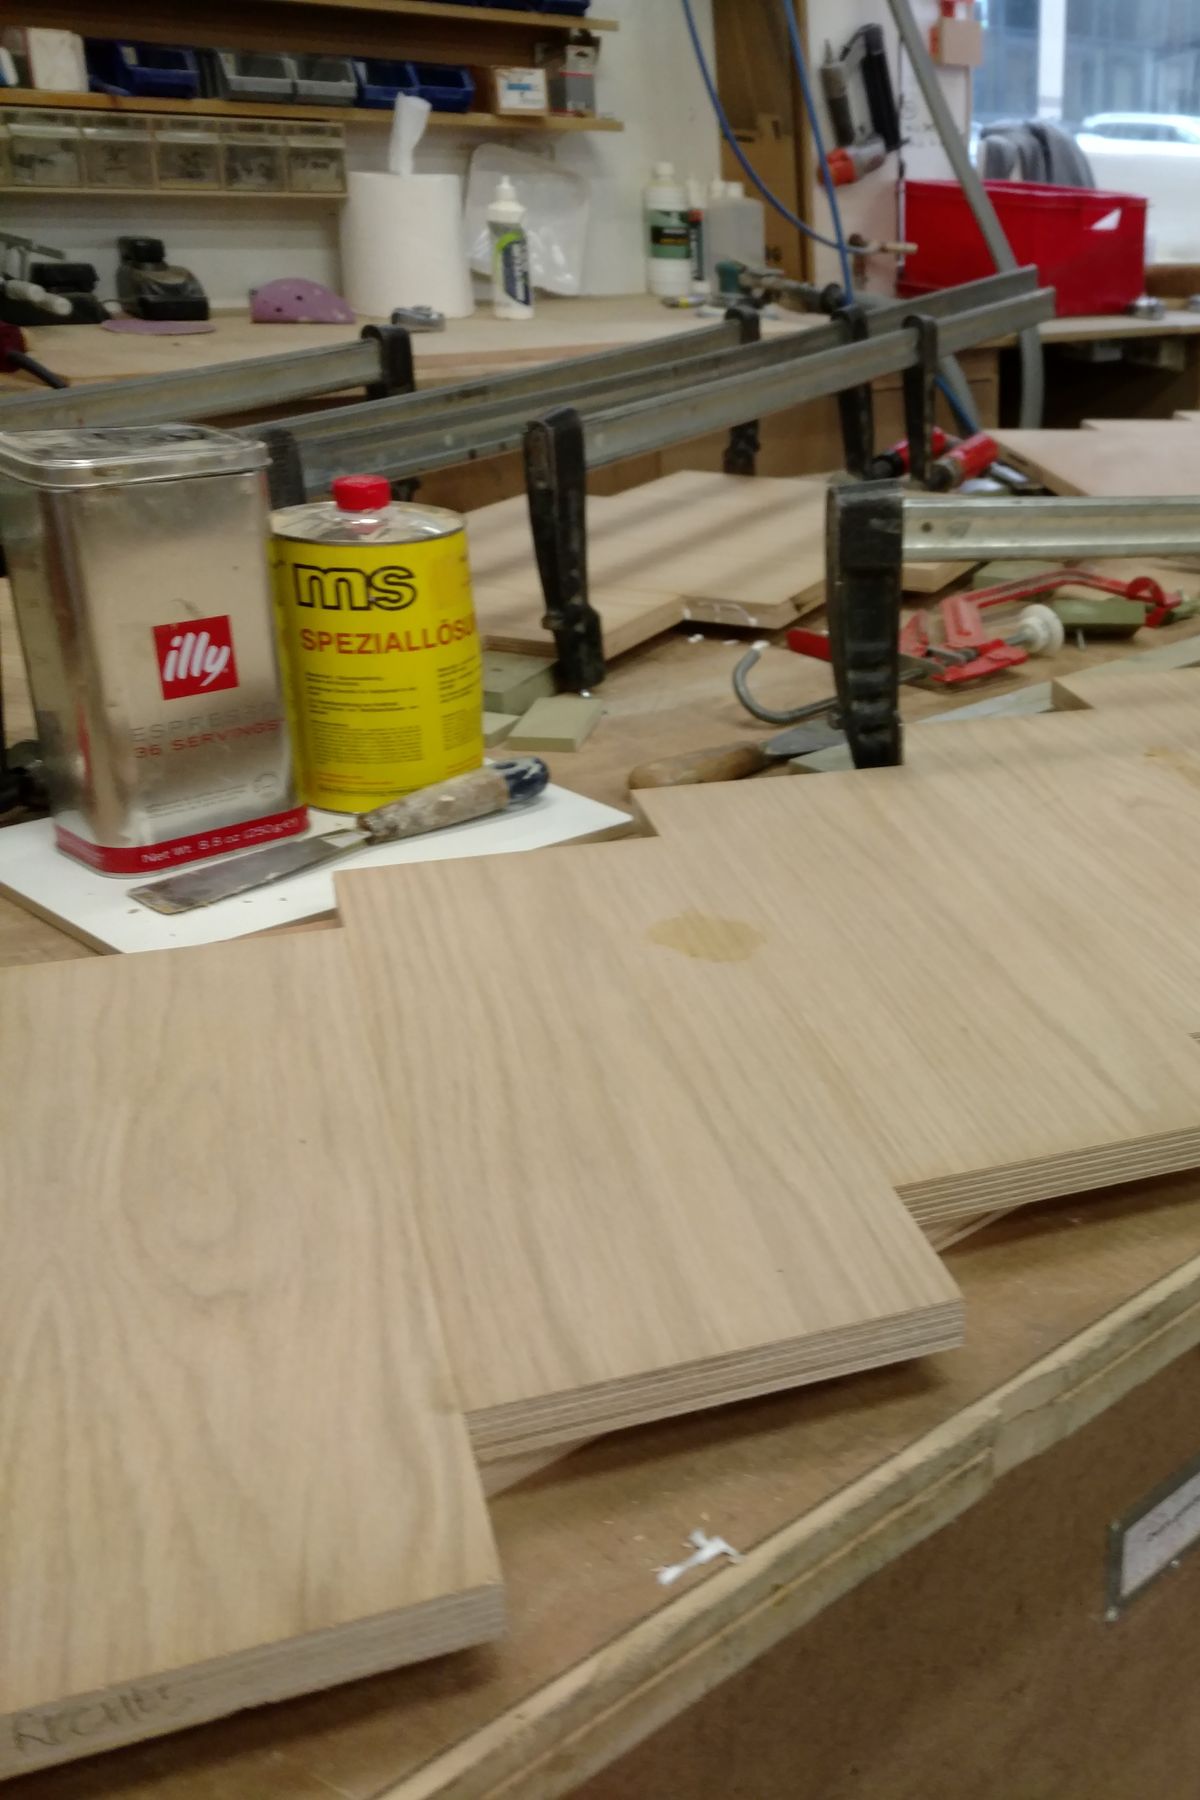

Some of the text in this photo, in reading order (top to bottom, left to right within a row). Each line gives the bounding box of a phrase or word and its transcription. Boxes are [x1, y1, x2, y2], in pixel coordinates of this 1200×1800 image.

[293, 563, 418, 611] ms
[163, 631, 231, 686] illy
[129, 703, 281, 742] ESPRESSO
[170, 719, 281, 751] SERVINGS
